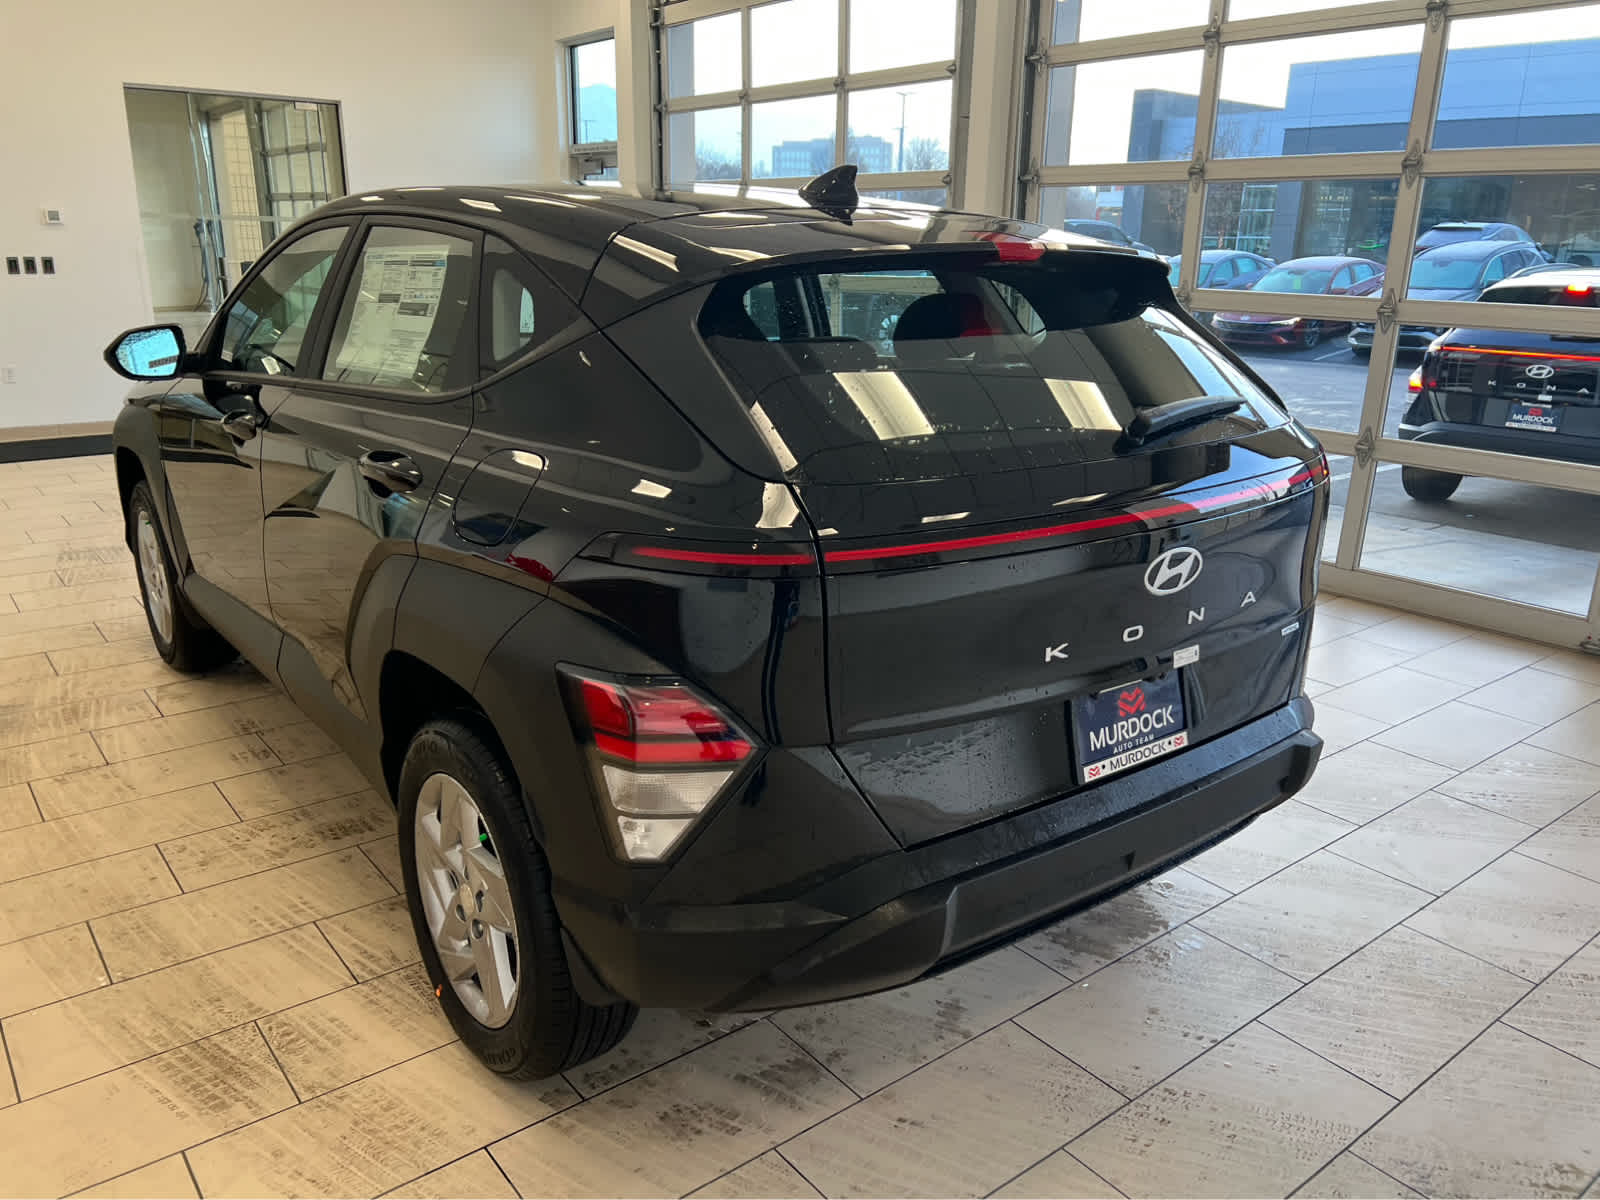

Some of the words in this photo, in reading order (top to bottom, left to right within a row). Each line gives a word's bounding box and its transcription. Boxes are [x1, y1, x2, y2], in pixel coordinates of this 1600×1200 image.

[1512, 414, 1554, 424] MURDOCK
[1089, 704, 1175, 752] MURDOCK
[1113, 741, 1133, 754] AUTO
[1135, 734, 1155, 747] TEAM
[1109, 742, 1167, 771] MURDOCK
